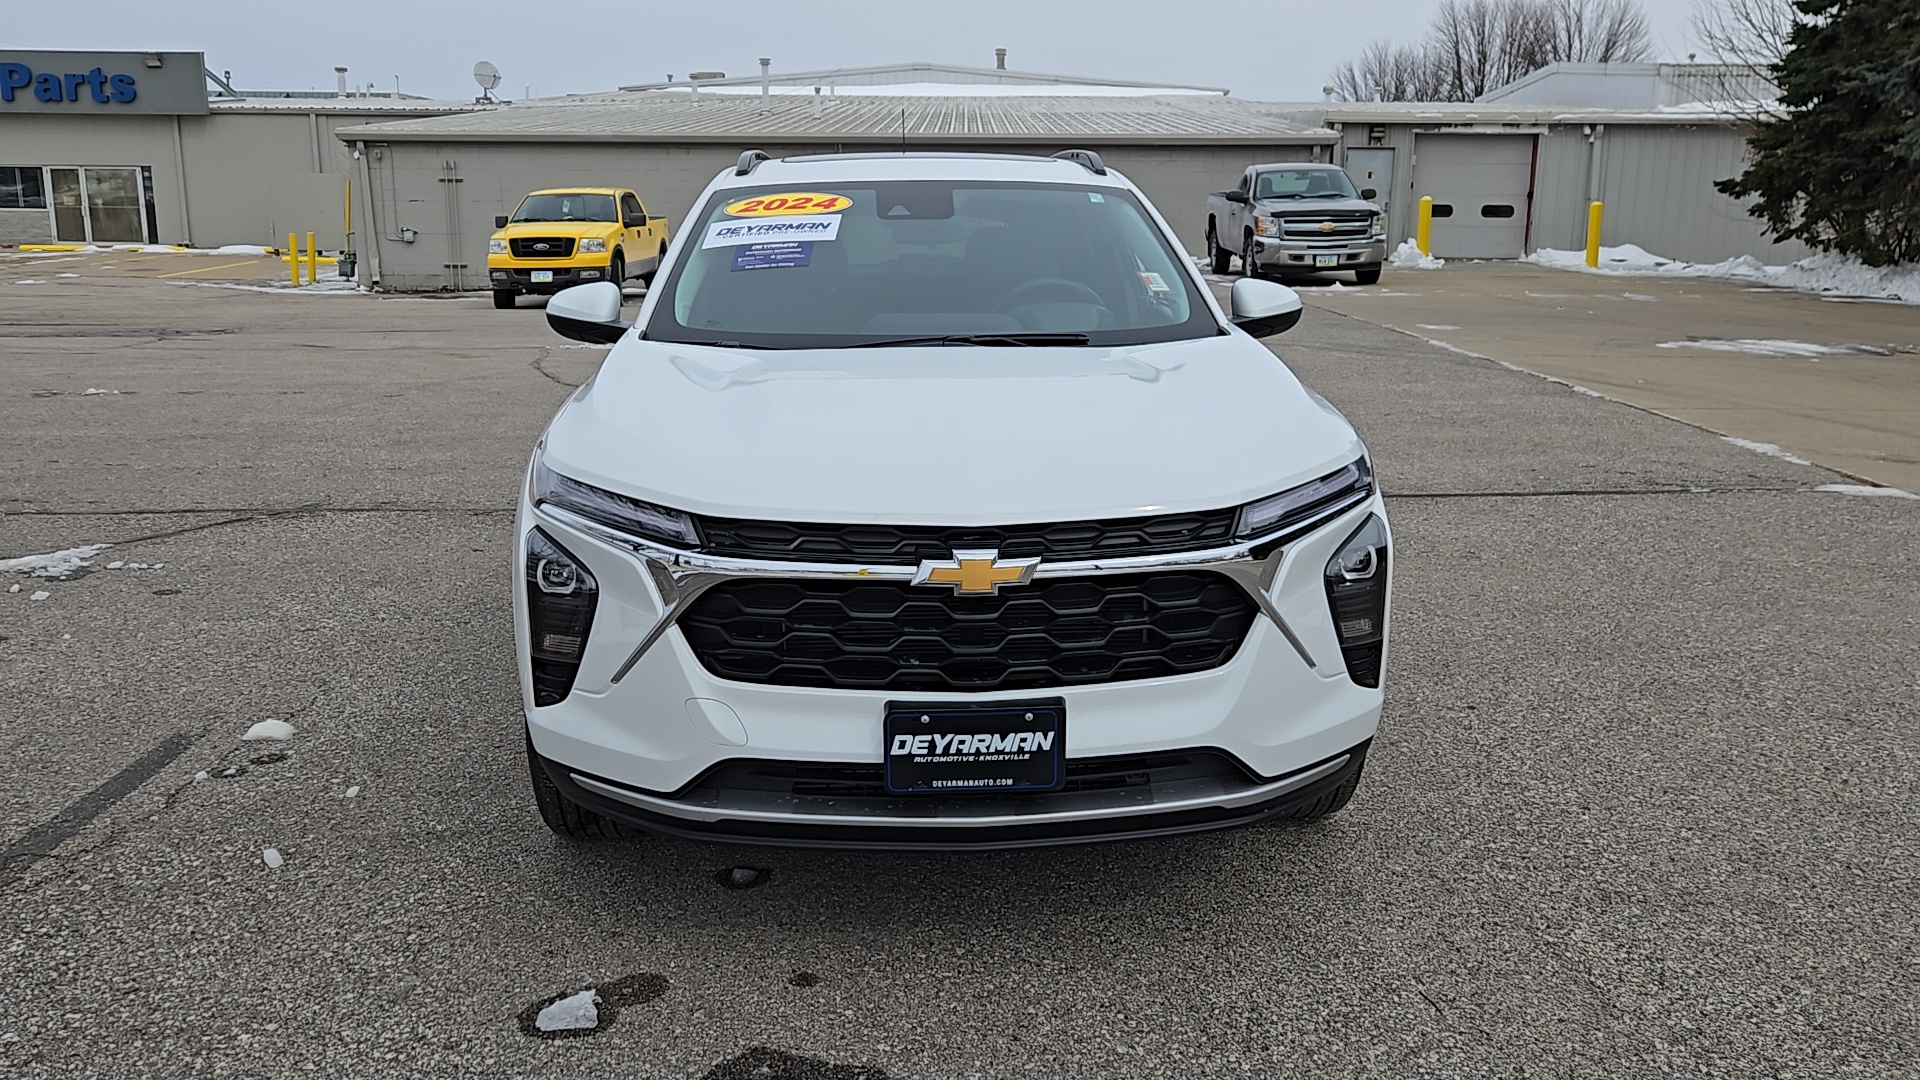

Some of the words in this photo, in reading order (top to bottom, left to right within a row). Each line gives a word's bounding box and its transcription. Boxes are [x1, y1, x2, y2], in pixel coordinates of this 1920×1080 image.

[0, 62, 137, 103] Parts
[735, 197, 840, 213] 2024
[715, 222, 832, 236] DEYARMAN
[722, 231, 769, 239] CERTIFIED
[890, 731, 1055, 755] DEYARMAN
[933, 779, 1013, 787] DEYARMANAUTO.COM
